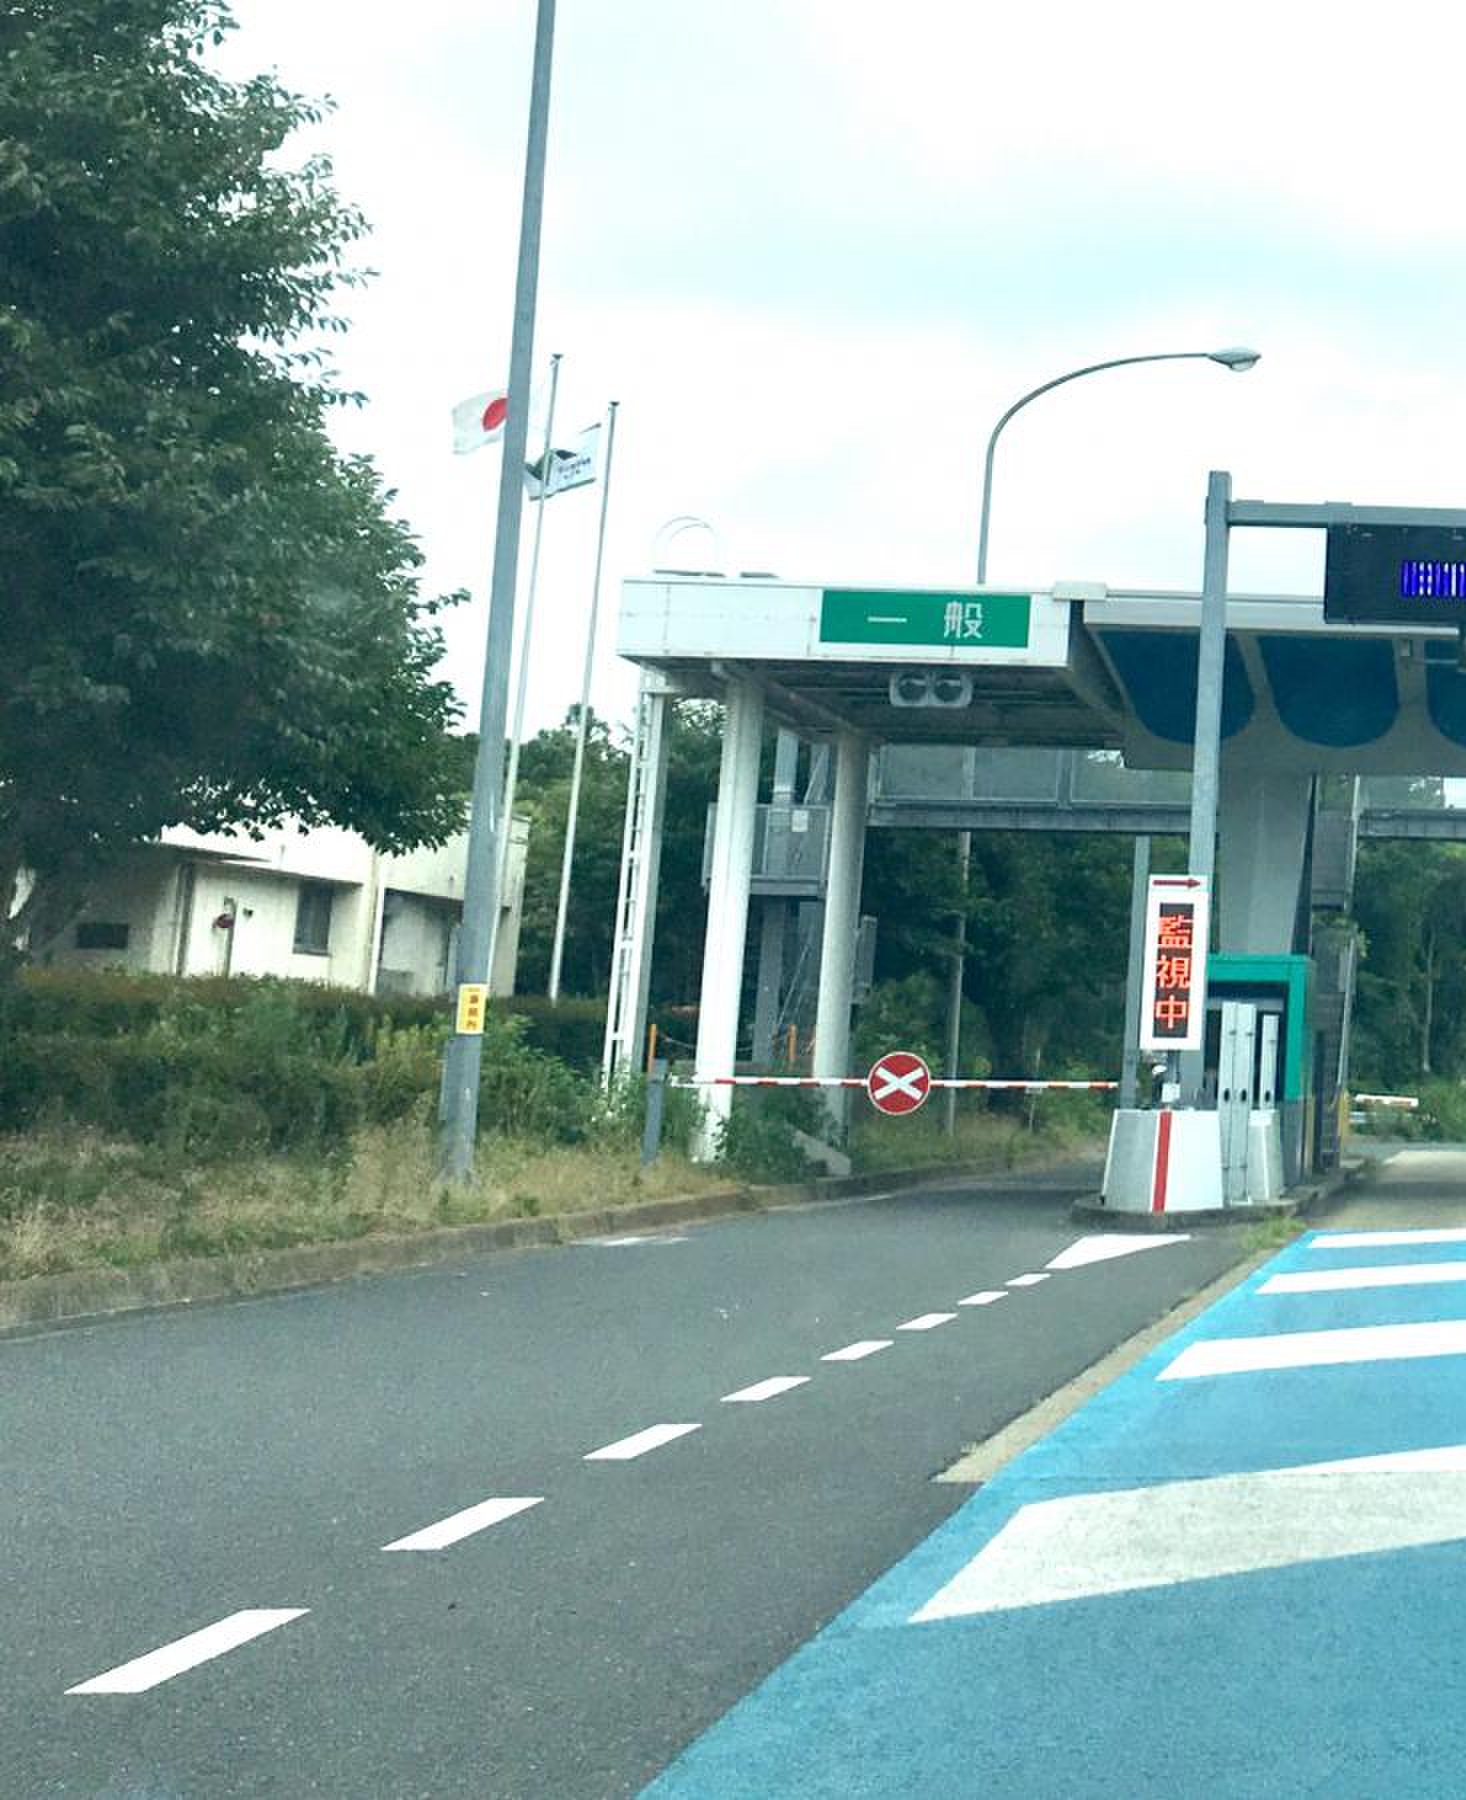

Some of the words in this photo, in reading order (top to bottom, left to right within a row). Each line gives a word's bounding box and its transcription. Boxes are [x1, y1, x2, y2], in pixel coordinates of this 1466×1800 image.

[866, 600, 983, 639] 一般
[1155, 914, 1193, 1030] 監視中
